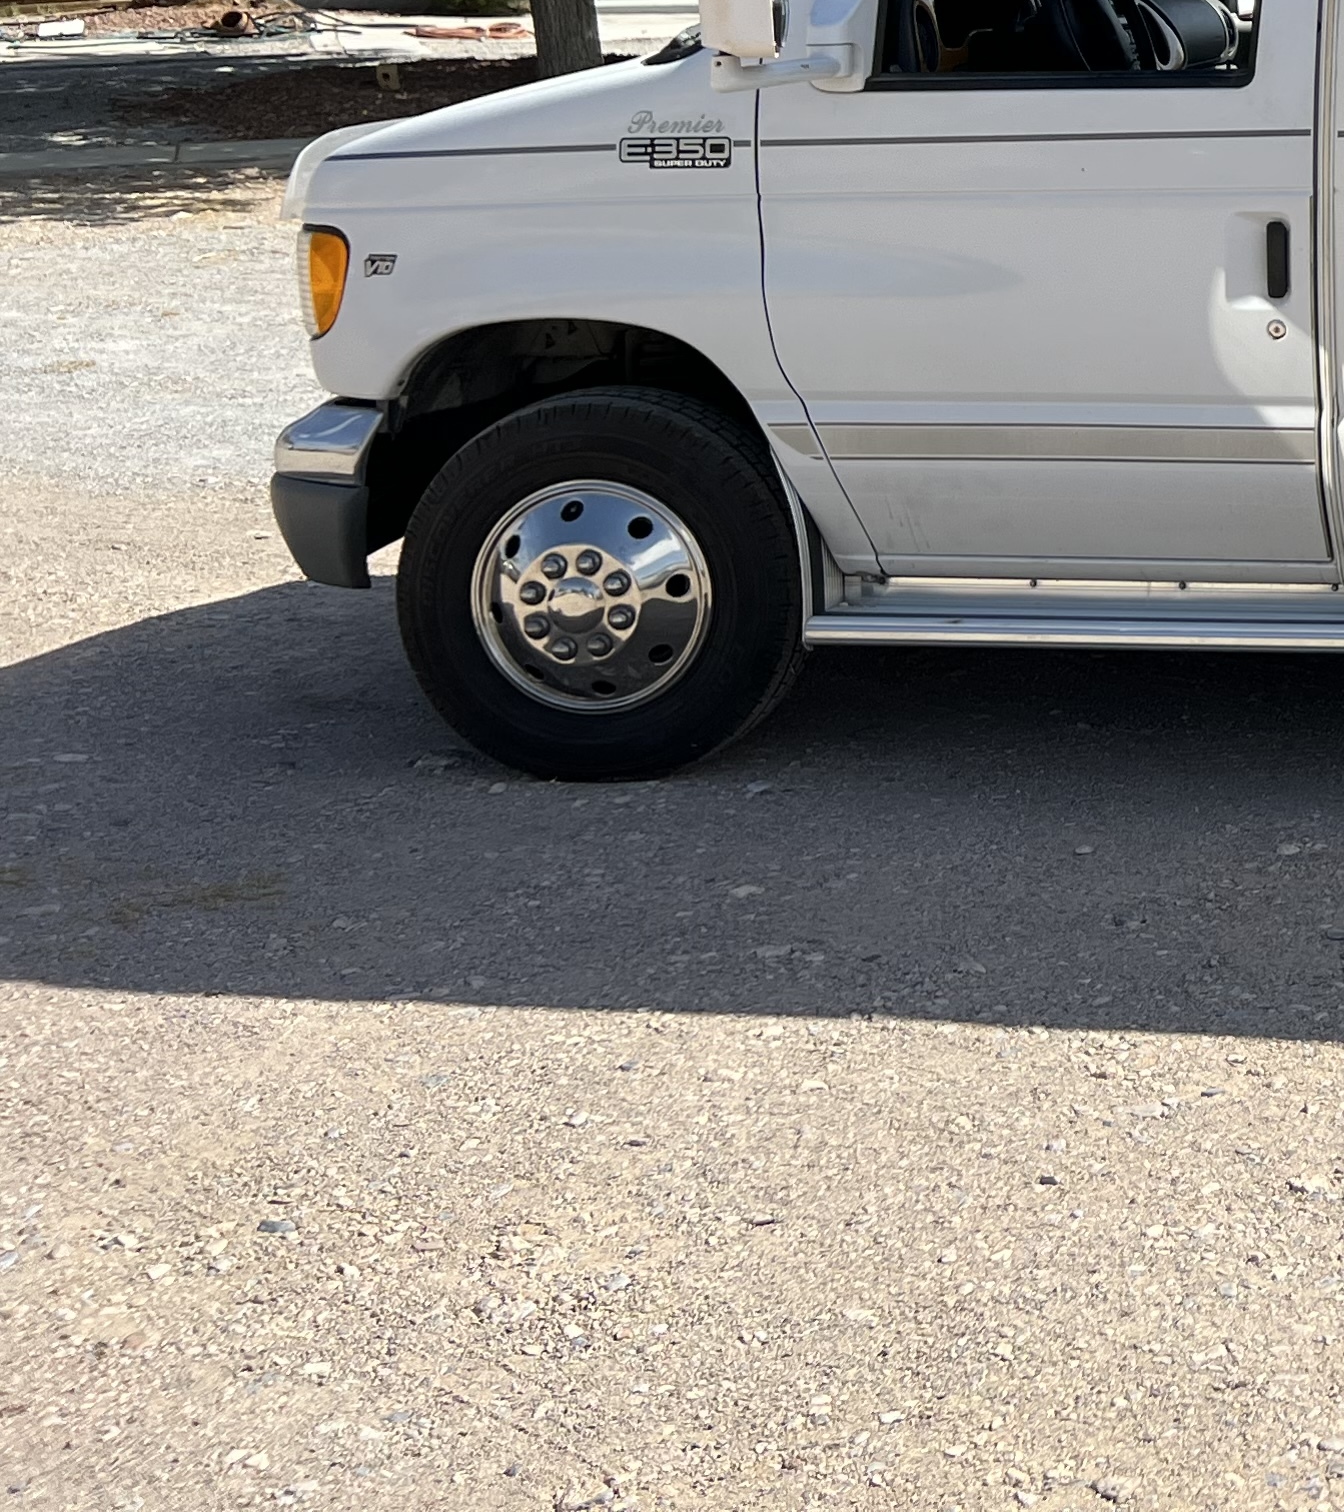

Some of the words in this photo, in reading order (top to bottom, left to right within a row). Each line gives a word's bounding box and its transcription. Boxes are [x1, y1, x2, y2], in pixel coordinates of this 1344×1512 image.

[628, 110, 725, 134] Premier
[653, 159, 693, 168] SUPER
[695, 159, 727, 168] DUTY
[364, 260, 396, 278] V10
